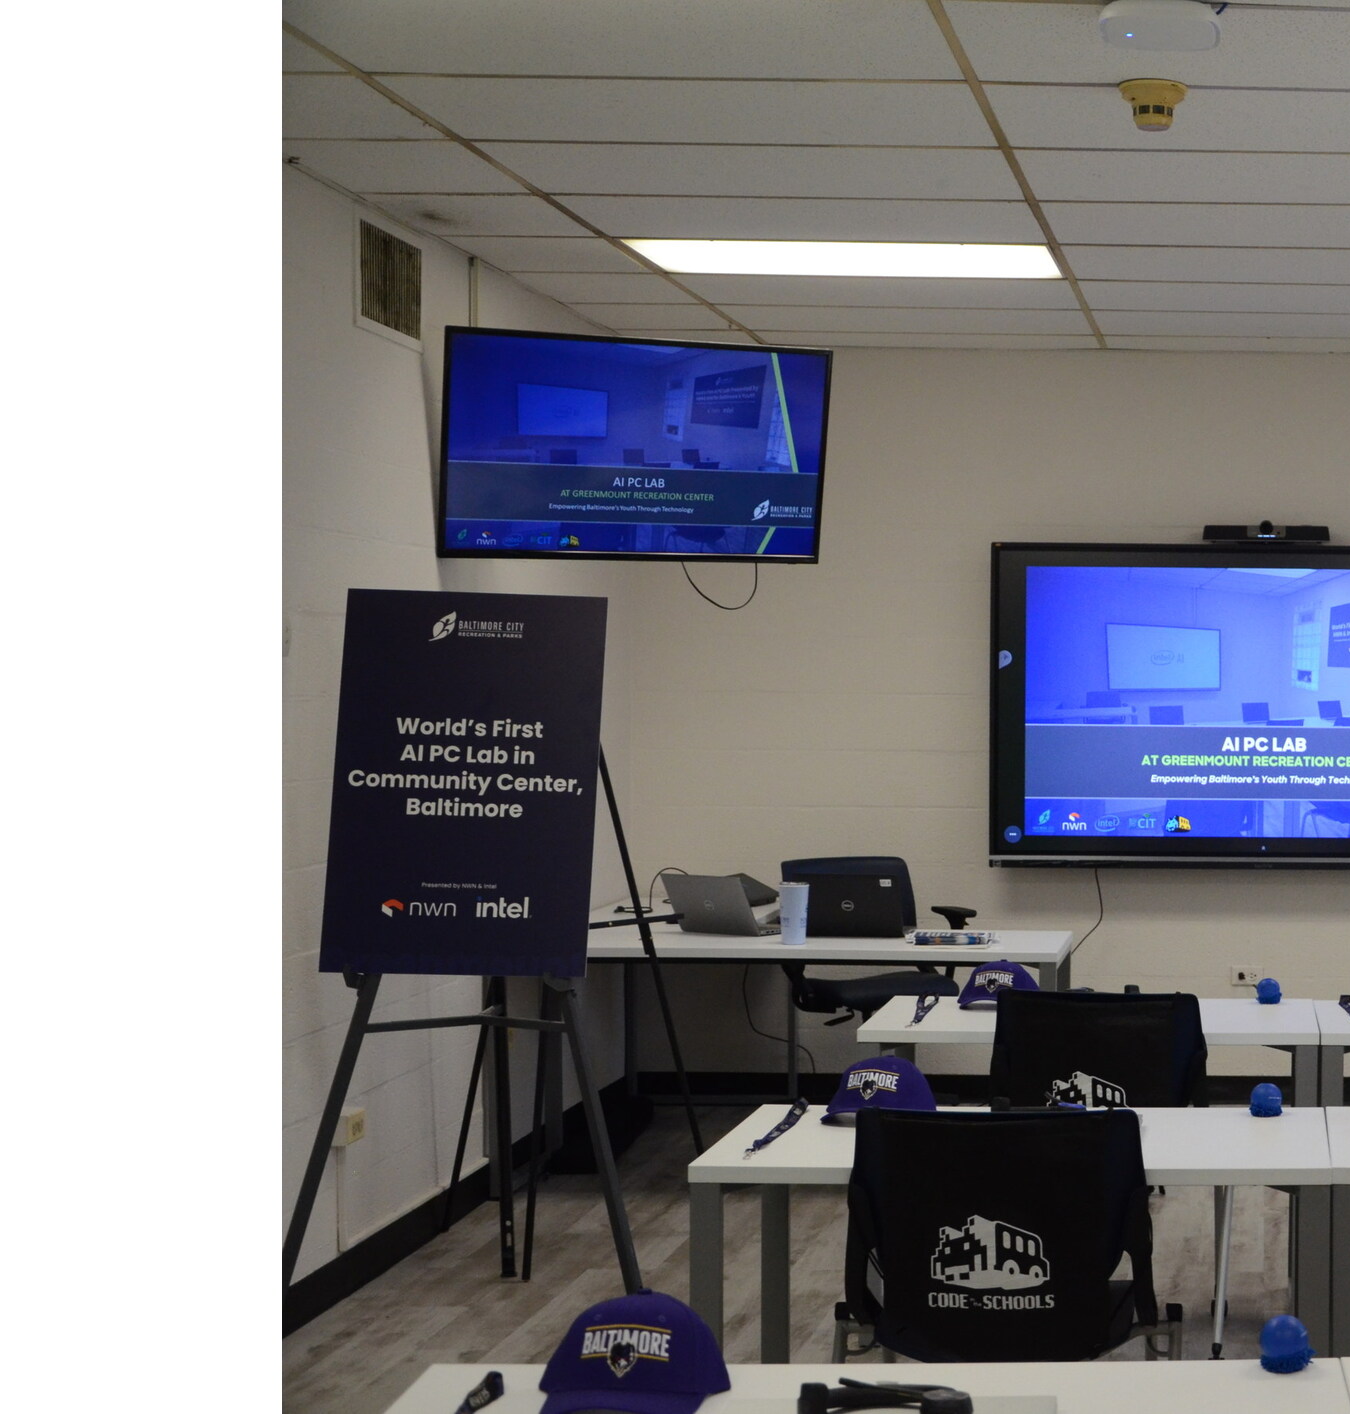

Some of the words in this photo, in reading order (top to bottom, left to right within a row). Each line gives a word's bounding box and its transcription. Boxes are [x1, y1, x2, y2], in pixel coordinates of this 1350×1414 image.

[613, 477, 624, 487] AI
[628, 478, 642, 487] PC
[645, 478, 665, 488] LAB
[572, 490, 631, 499] GREENMOUNT
[634, 492, 682, 500] RECREATION
[684, 493, 714, 501] CENTER
[549, 503, 586, 511] Empowering
[662, 506, 694, 514] Technology
[459, 621, 503, 631] BALTIMORE
[506, 622, 524, 631] CITY
[396, 717, 486, 736] World's
[492, 719, 544, 738] First
[1222, 737, 1240, 751] AI
[1244, 737, 1268, 752] PC
[1273, 737, 1307, 752] LAB
[400, 744, 424, 762] AI
[429, 745, 460, 762] PC
[466, 746, 508, 764] Lab
[514, 745, 535, 765] in
[1141, 755, 1159, 766] AT
[1161, 755, 1250, 766] GREENMOUNT
[1253, 755, 1334, 767] RECREATION
[348, 769, 492, 796] Community
[497, 774, 583, 795] Center,
[1150, 774, 1207, 785] Empowering
[1209, 775, 1259, 784] Baltimore's
[1262, 775, 1287, 784] Youth
[1290, 775, 1326, 785] Through
[406, 797, 523, 818] Baltimore
[1062, 822, 1086, 831] nwn
[1098, 819, 1116, 828] intel
[1138, 818, 1156, 829] CIT
[409, 901, 457, 917] nwn
[975, 973, 1014, 985] BALTIMORE
[847, 1071, 899, 1089] BALTIMORE
[928, 1292, 969, 1309] CODE
[983, 1294, 1055, 1310] SCHOOLS
[582, 1329, 671, 1357] BALTIMORE
